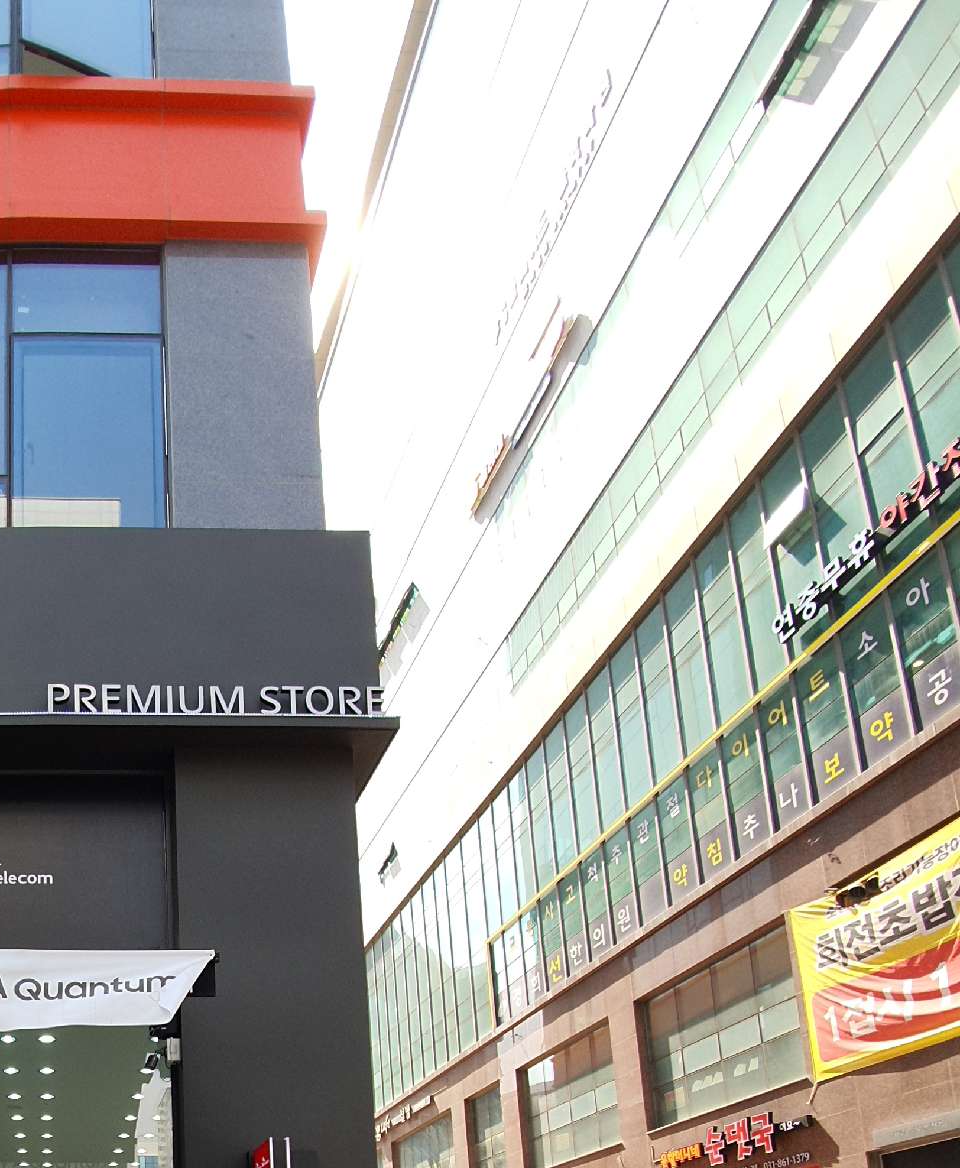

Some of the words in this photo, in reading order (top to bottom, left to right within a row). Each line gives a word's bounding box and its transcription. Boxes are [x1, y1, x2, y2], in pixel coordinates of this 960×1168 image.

[771, 528, 876, 643] 연중무휴
[47, 683, 245, 714] PREMIUM
[259, 685, 385, 716] STORE
